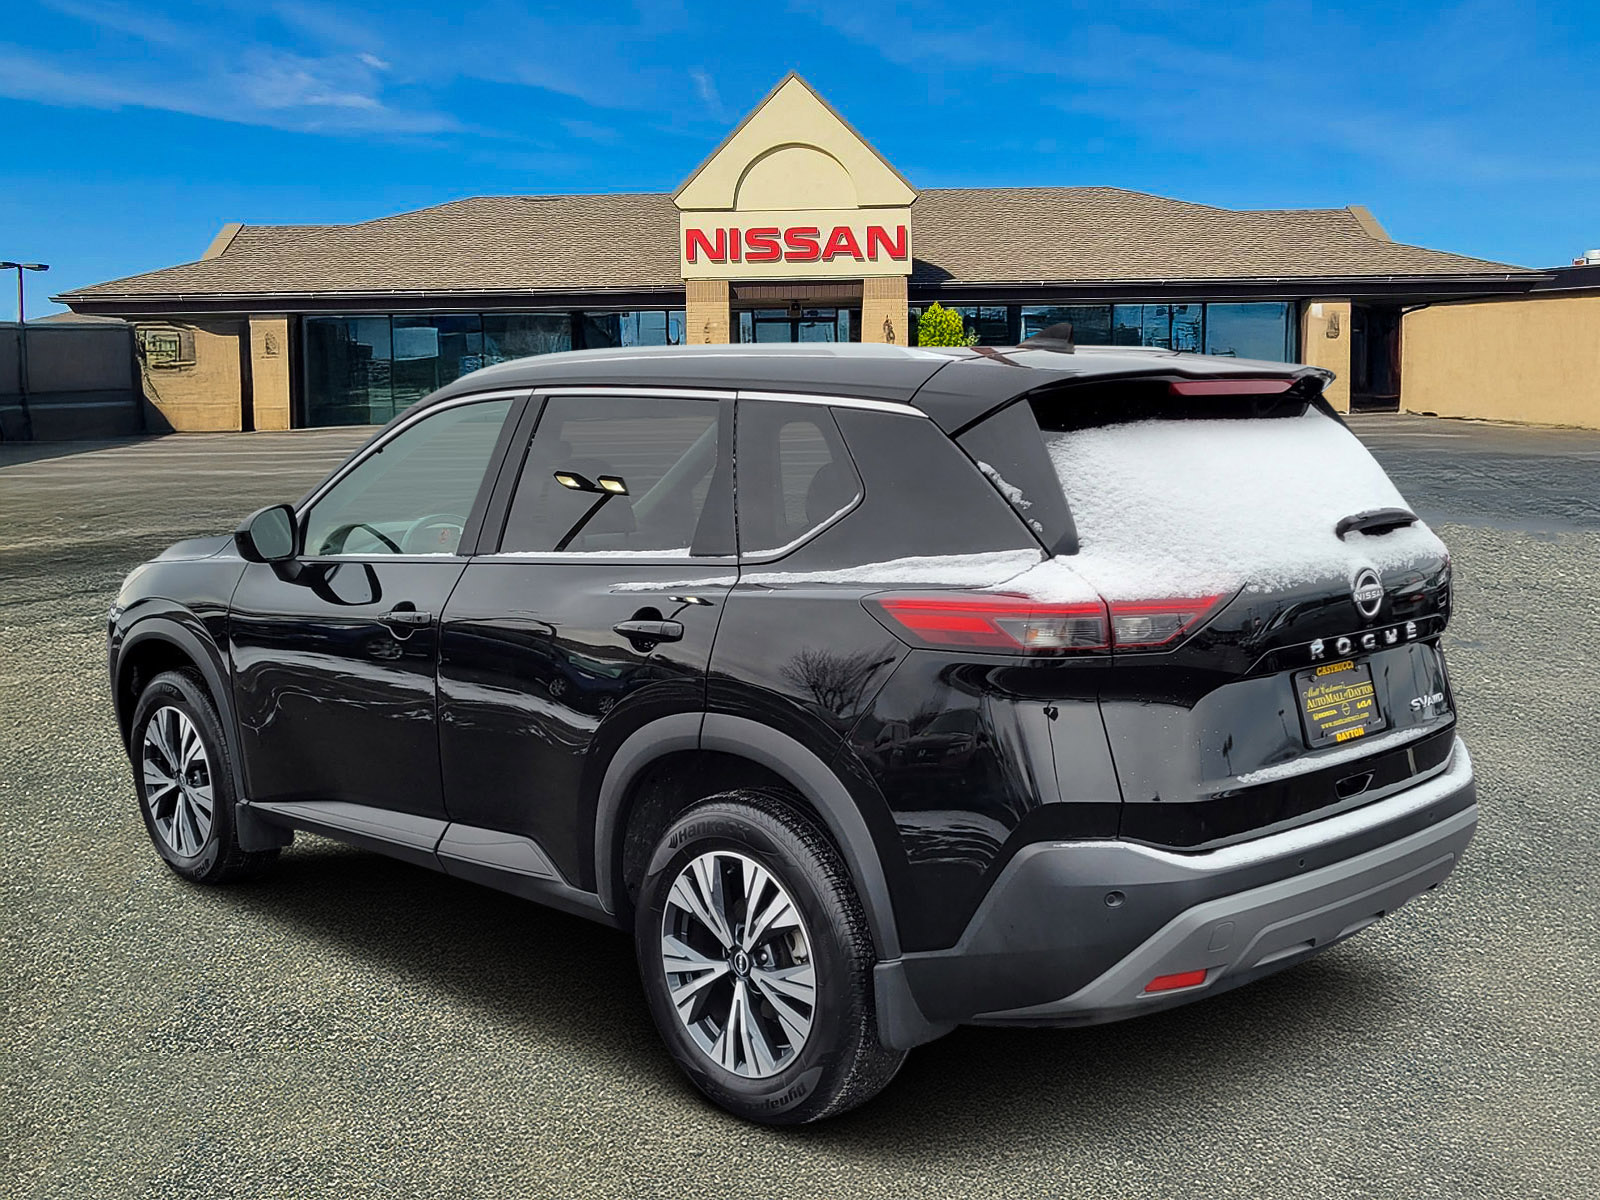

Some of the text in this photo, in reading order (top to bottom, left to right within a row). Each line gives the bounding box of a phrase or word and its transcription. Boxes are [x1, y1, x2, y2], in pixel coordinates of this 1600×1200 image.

[685, 225, 908, 264] NISSAN
[1310, 620, 1417, 660] ROGUE
[1336, 727, 1365, 742] DAYTON
